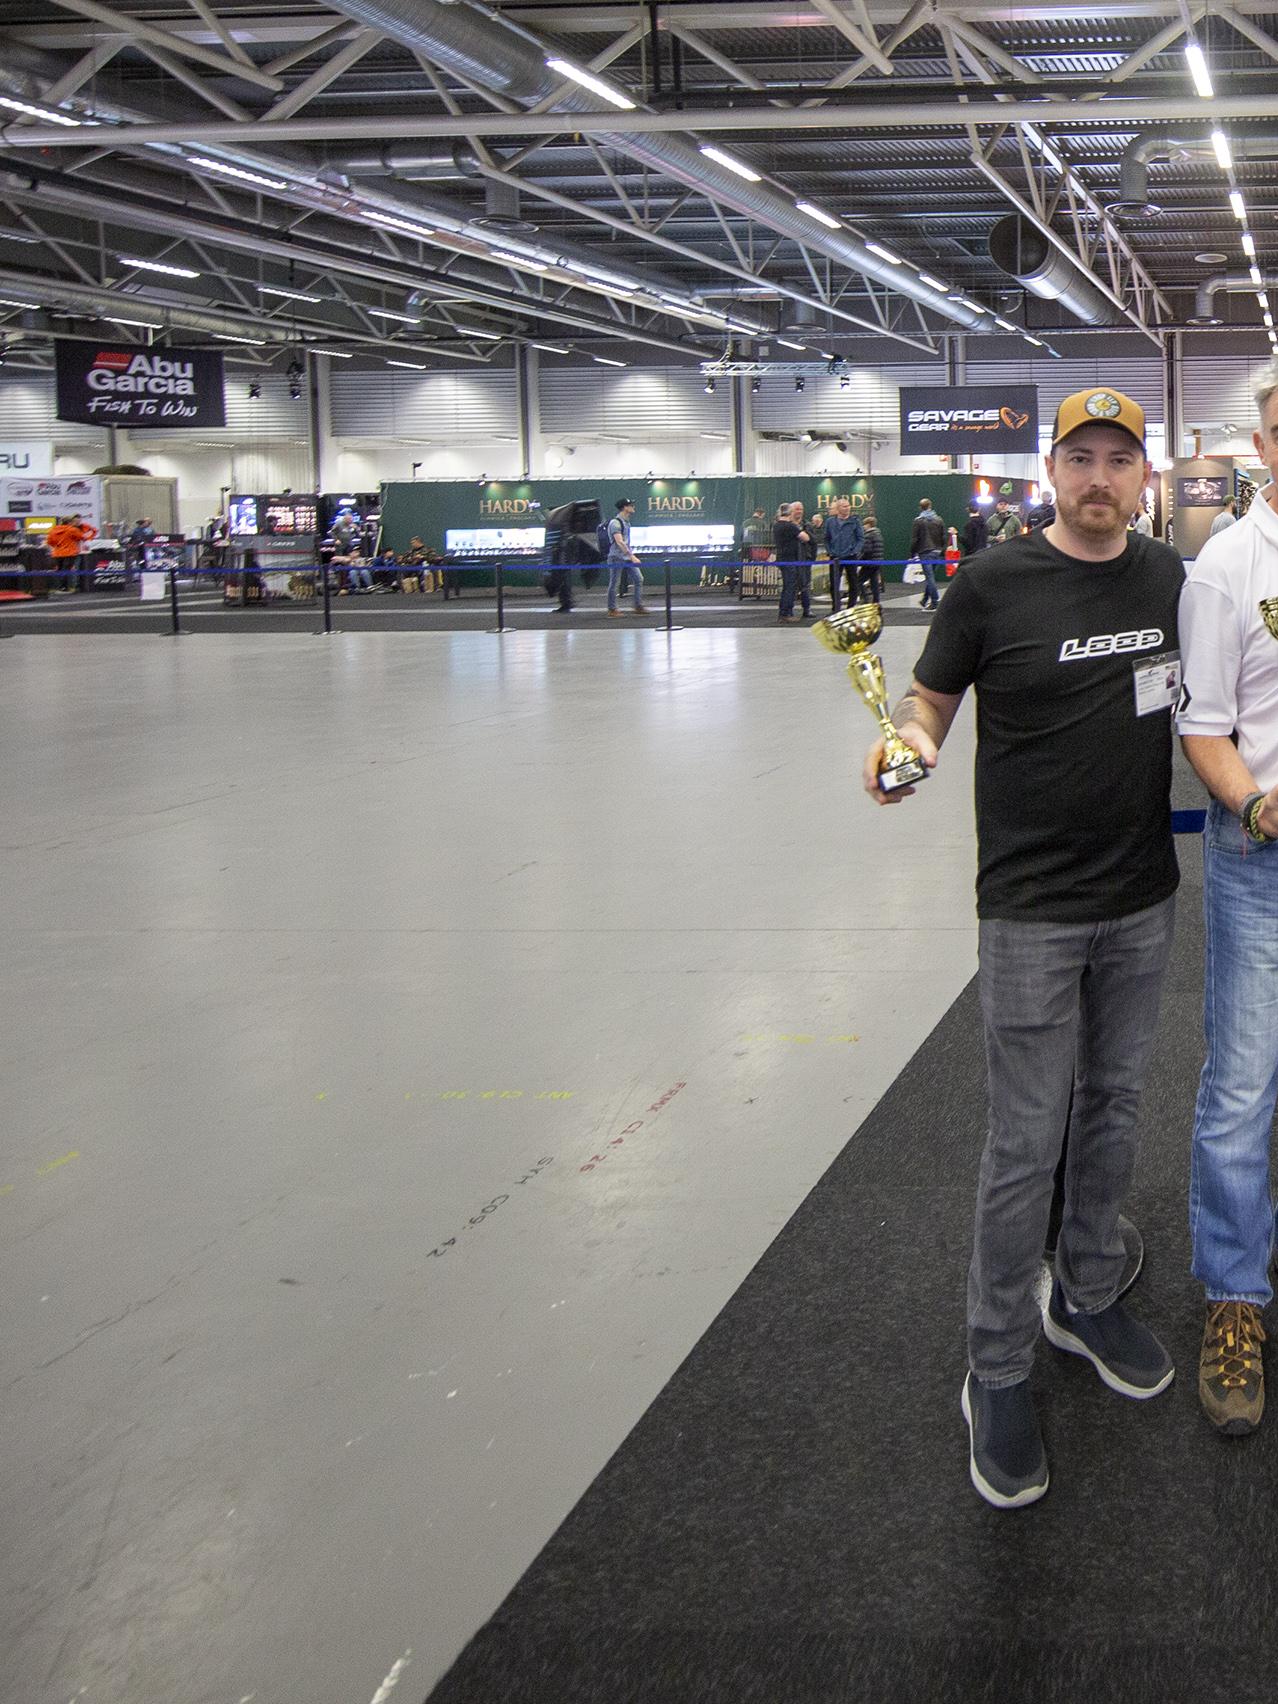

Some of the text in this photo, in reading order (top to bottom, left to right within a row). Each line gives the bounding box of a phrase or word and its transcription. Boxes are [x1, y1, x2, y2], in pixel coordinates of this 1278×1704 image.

[127, 354, 194, 378] Abu
[87, 368, 197, 395] Garcia
[908, 410, 1000, 422] SAVAGE
[908, 423, 950, 431] GEAR
[648, 496, 706, 511] HARDY
